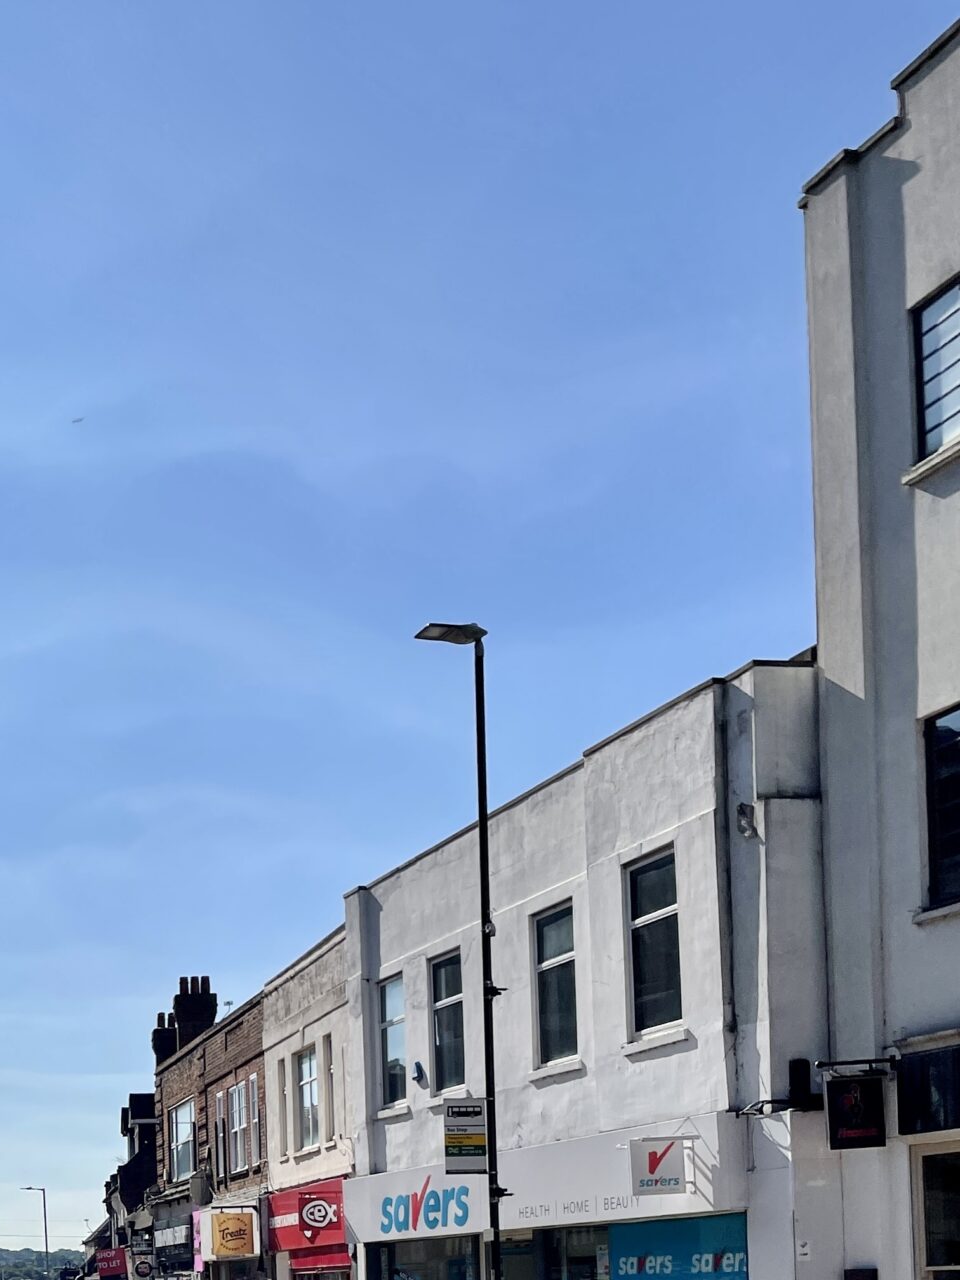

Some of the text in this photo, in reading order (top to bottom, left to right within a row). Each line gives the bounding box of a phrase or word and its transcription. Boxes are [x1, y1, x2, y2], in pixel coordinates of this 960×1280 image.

[639, 1176, 680, 1188] savers
[380, 1174, 470, 1234] savers
[518, 1194, 640, 1219] HEALTH HOME BEAUTY
[95, 1251, 116, 1259] SHOP
[109, 1260, 121, 1268] LET
[618, 1253, 673, 1275] savers
